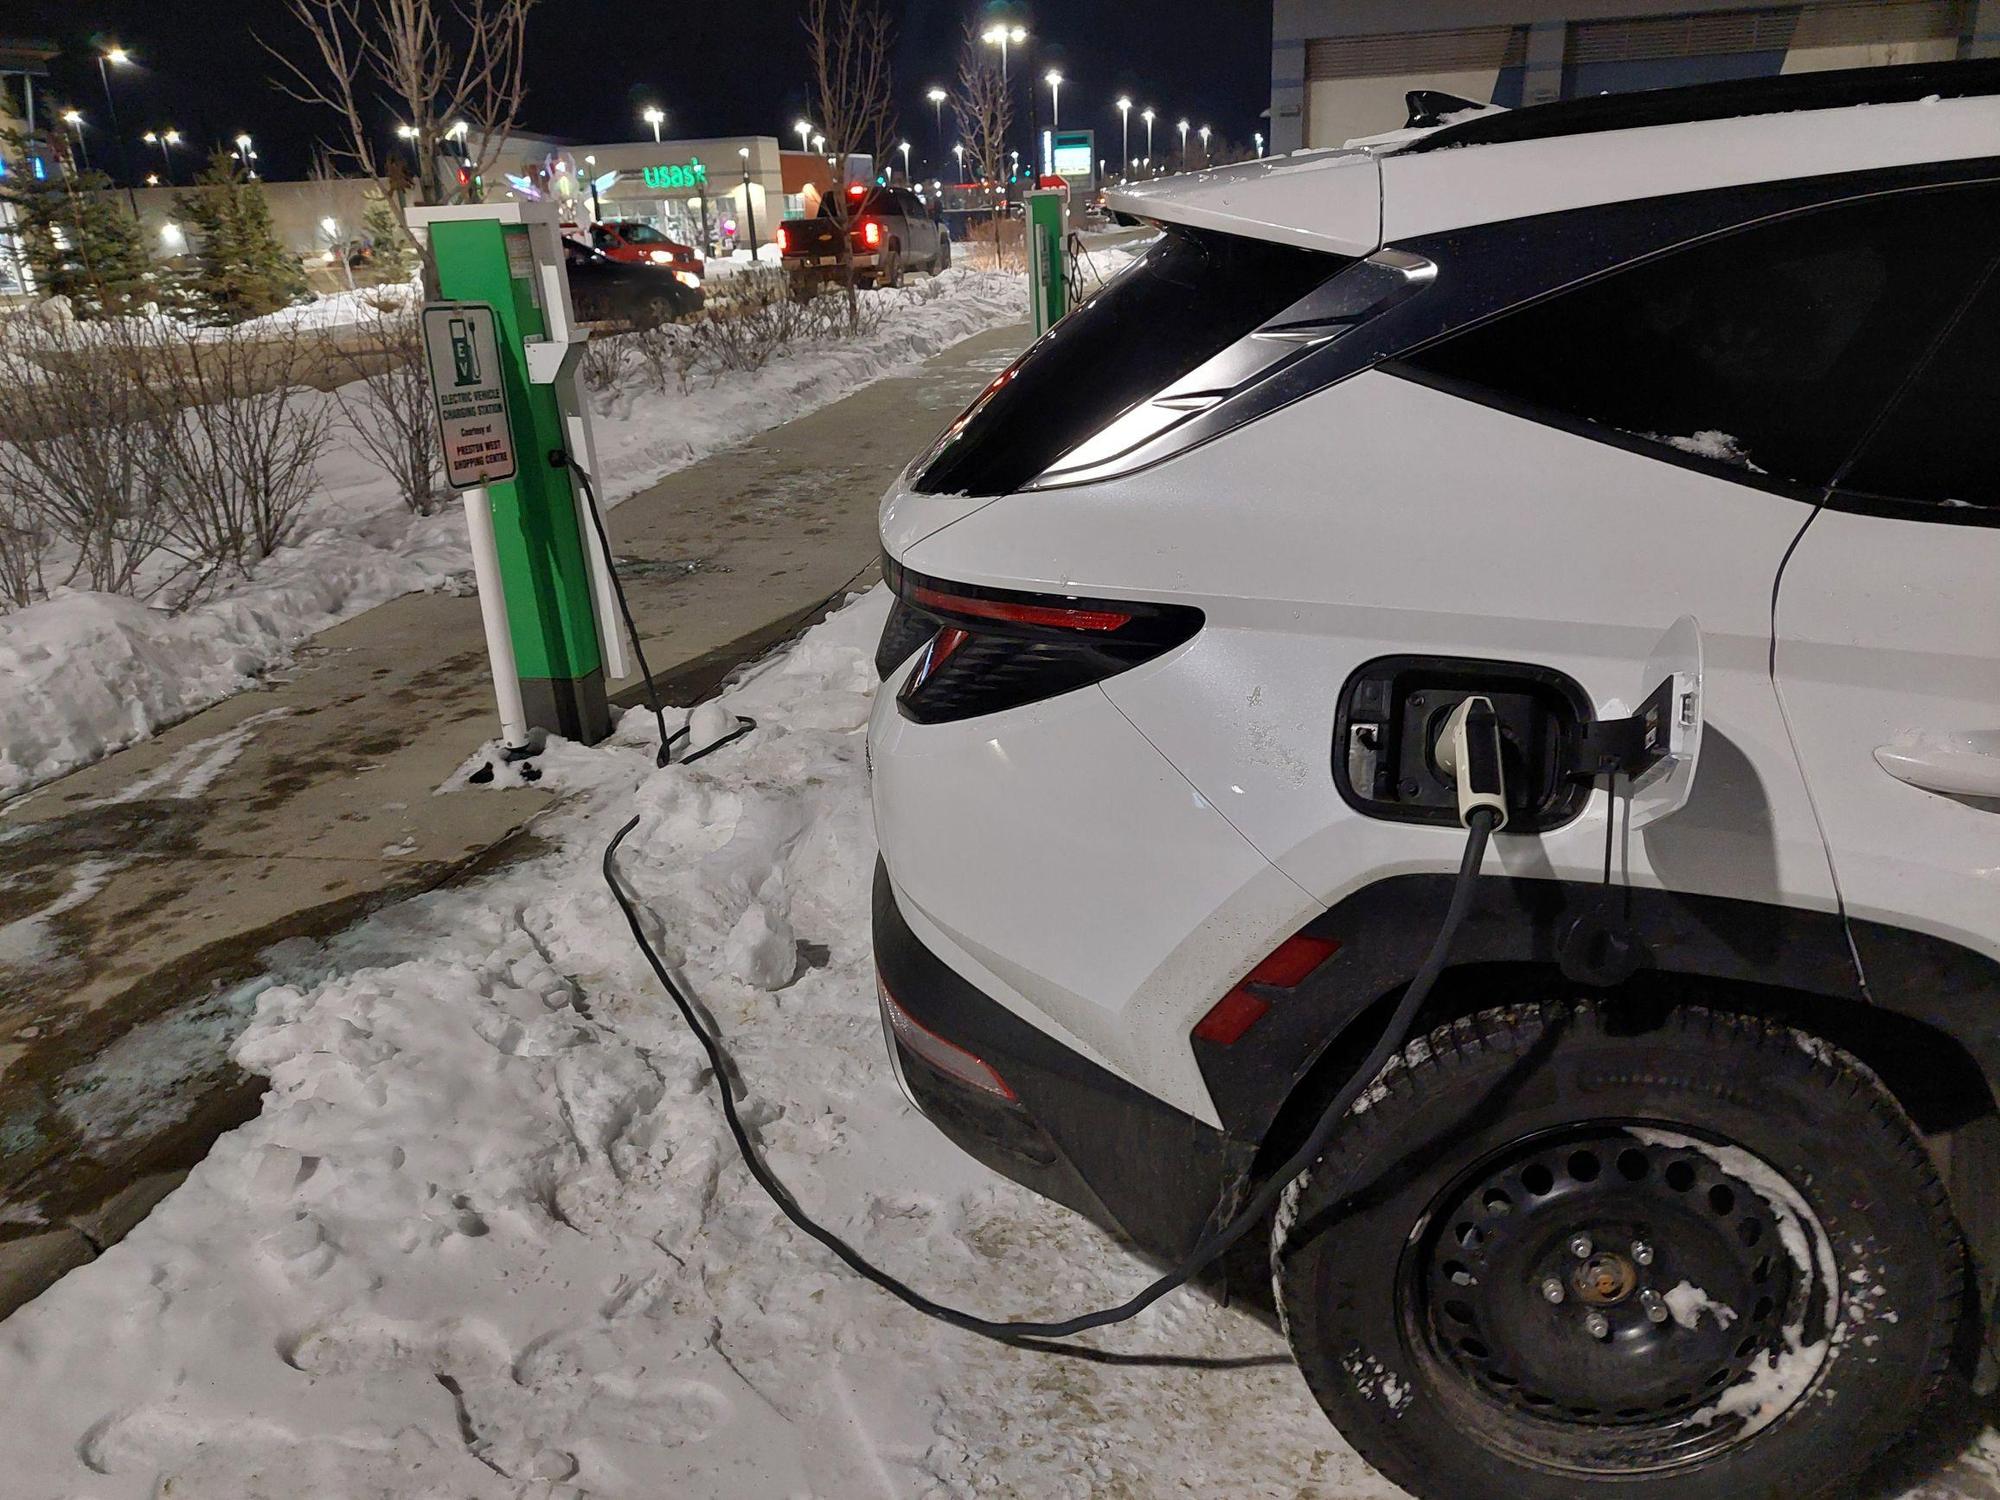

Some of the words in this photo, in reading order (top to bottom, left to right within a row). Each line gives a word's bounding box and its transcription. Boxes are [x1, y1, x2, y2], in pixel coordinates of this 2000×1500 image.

[441, 391, 473, 405] ELECTRIC
[474, 389, 500, 401] VEHICLE
[443, 407, 476, 420] CHARGING
[477, 403, 503, 415] STATION
[461, 427, 485, 437] Courtesy
[486, 424, 492, 433] of
[456, 443, 484, 456] PRESTON
[485, 440, 501, 451] WEST
[454, 456, 484, 470] SHOPPING
[485, 451, 508, 464] CENTRE
